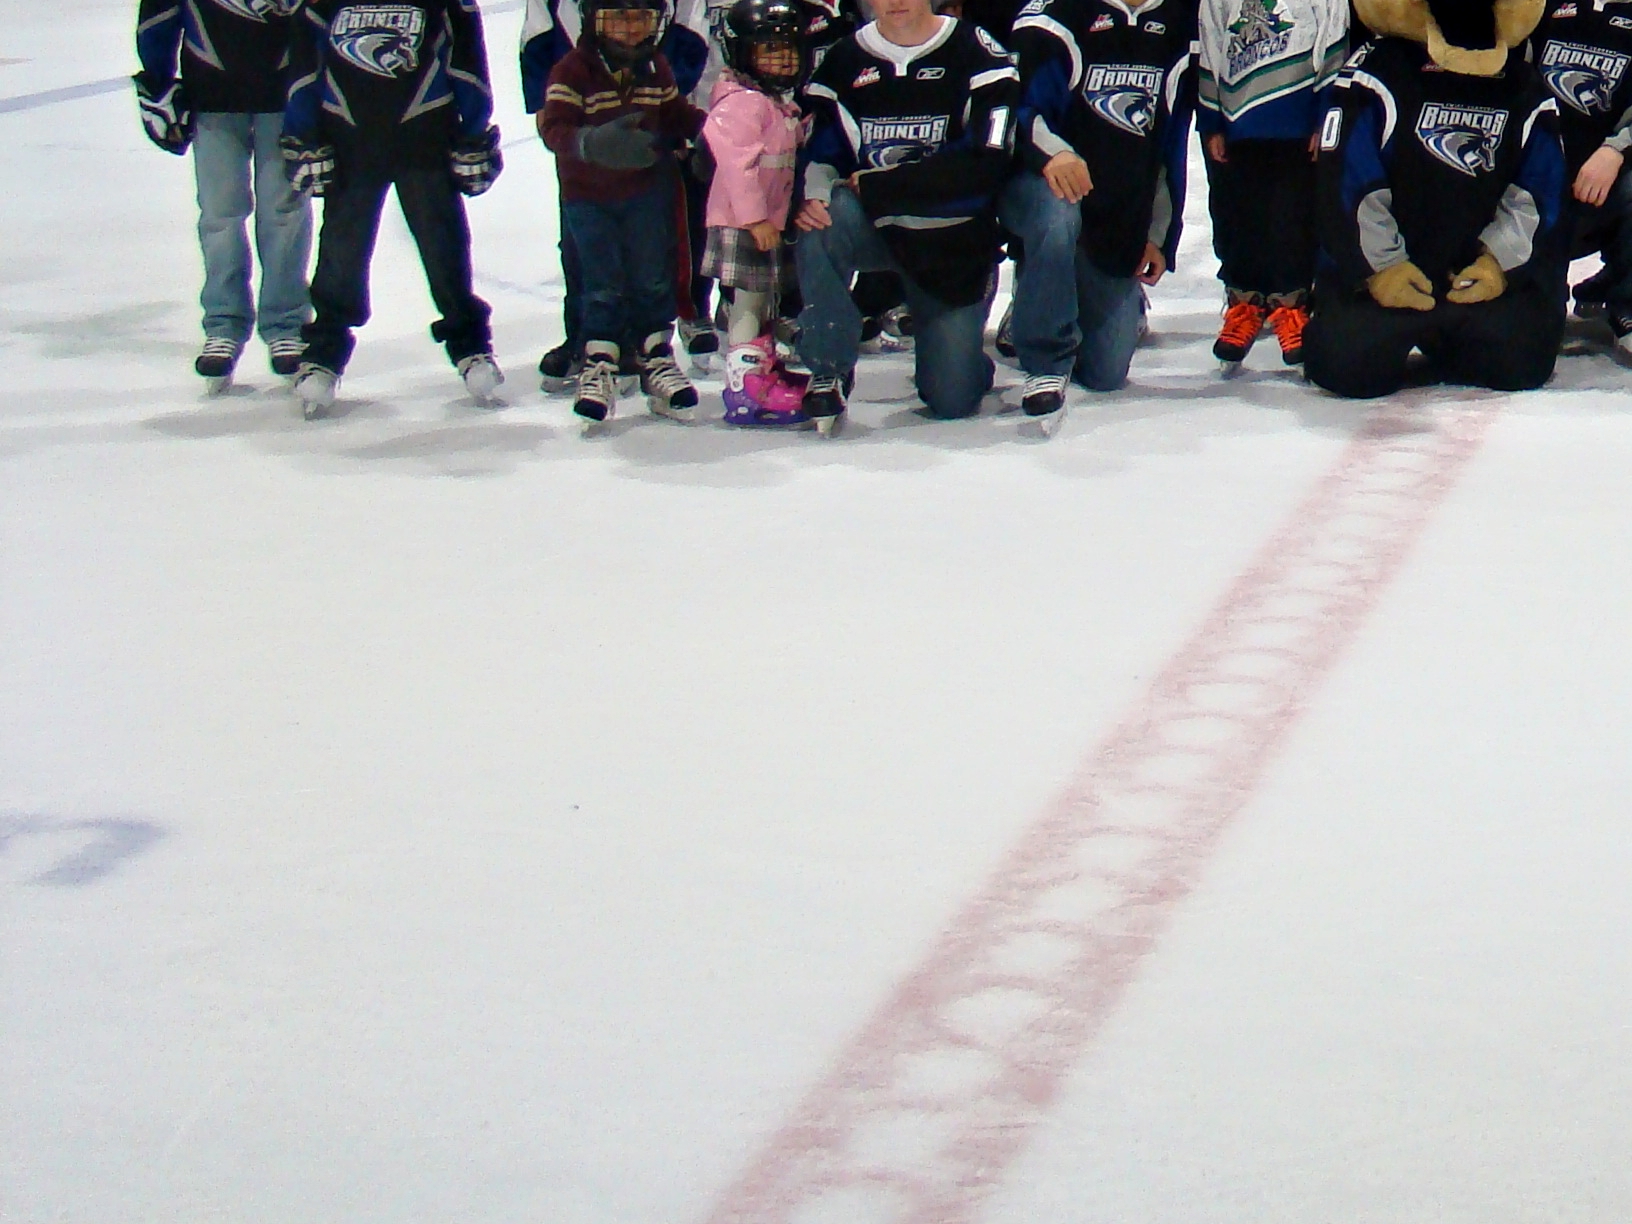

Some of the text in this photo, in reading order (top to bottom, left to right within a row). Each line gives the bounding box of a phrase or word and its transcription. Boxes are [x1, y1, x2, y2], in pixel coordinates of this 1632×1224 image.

[333, 8, 425, 33] BRONCOS
[1543, 42, 1628, 79] BRONCOS
[862, 117, 948, 145] BRONCOS
[987, 106, 1010, 150] 1
[1318, 107, 1343, 152] 0
[1421, 104, 1508, 128] BRONCOS
